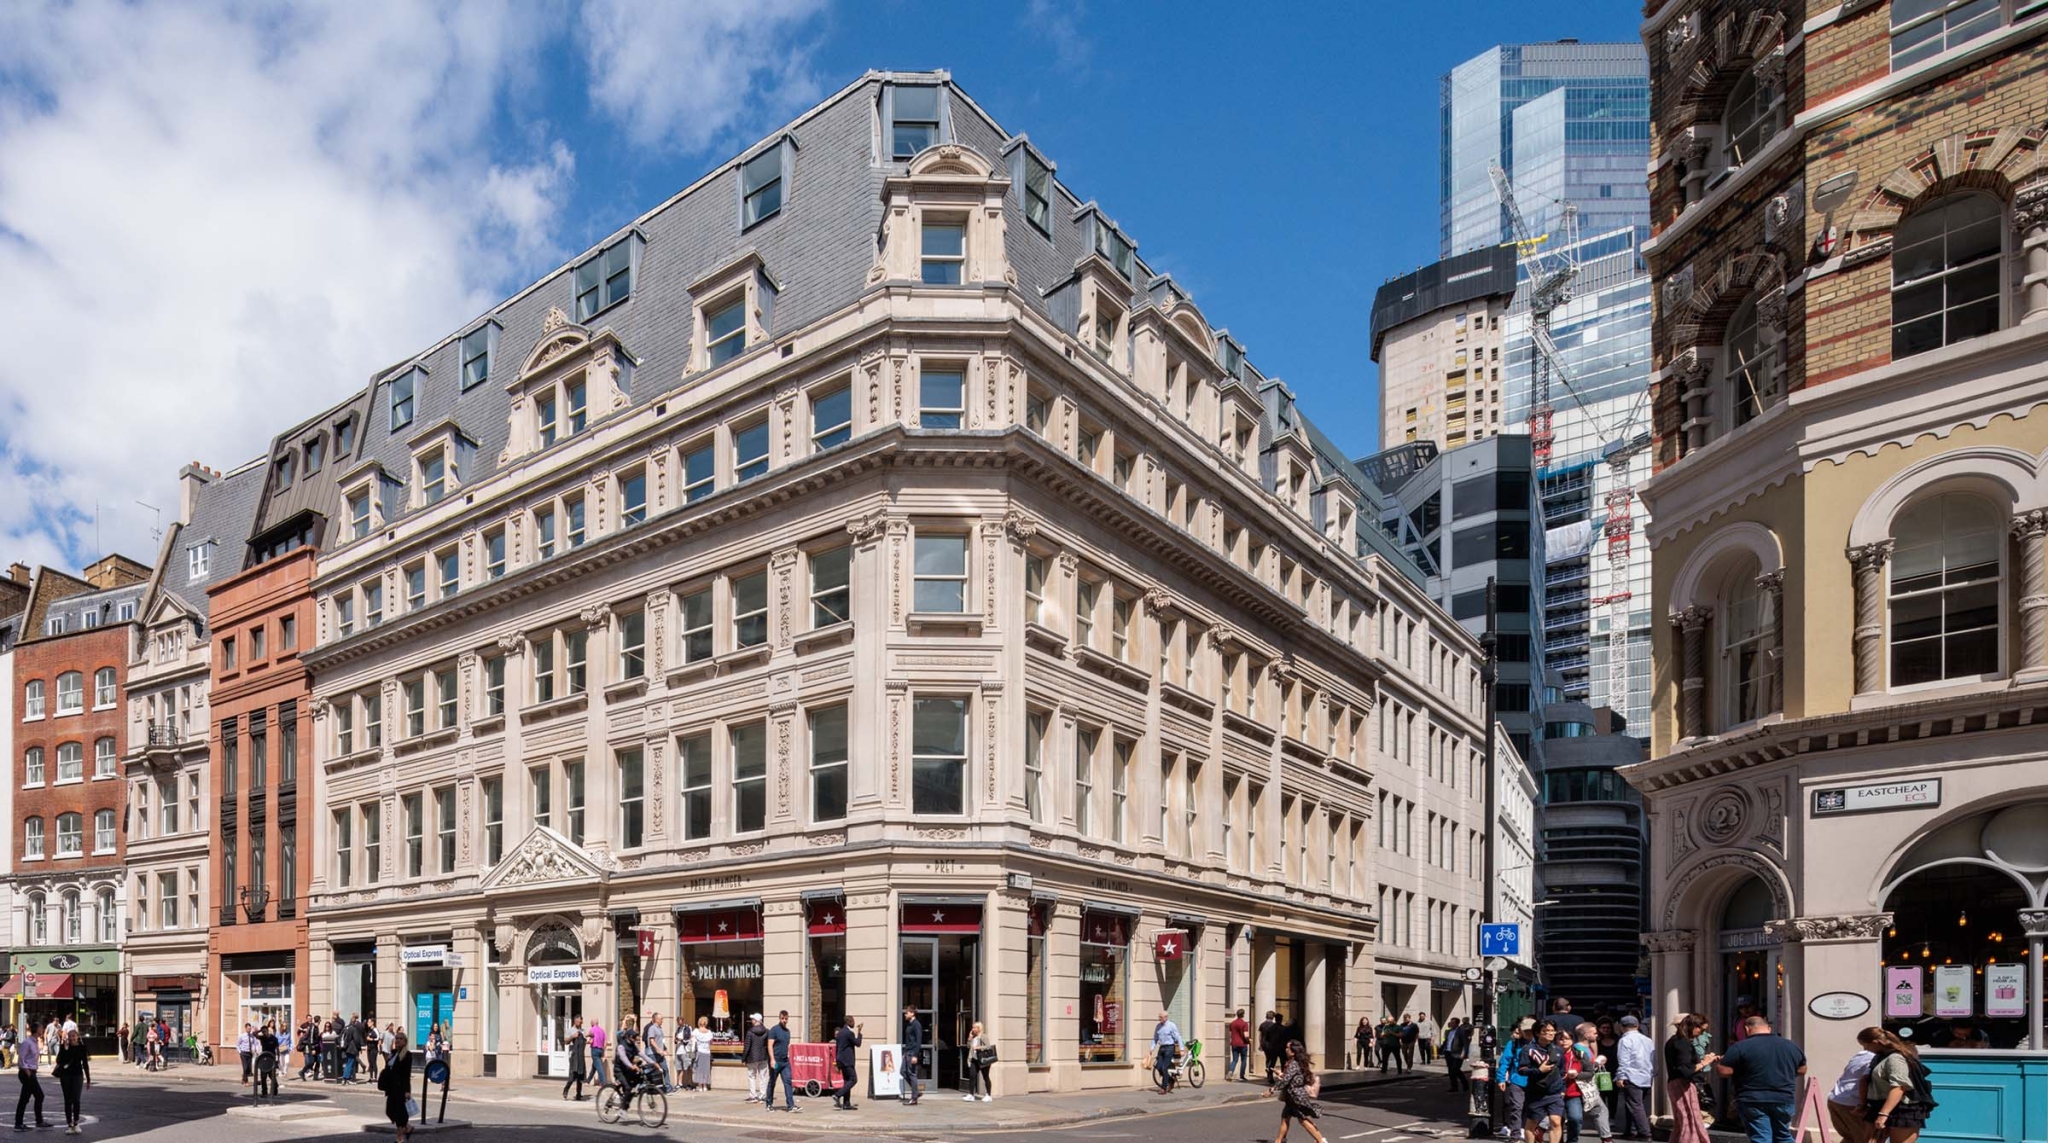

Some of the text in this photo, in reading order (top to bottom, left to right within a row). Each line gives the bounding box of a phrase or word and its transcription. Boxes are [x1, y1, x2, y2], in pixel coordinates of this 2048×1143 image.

[1858, 784, 1928, 798] EASTCHEAP
[1905, 793, 1928, 802] EC3
[1714, 805, 1740, 829] 23
[935, 859, 955, 874] PRET
[690, 878, 706, 892] PRET
[714, 874, 742, 890] MANGER
[1728, 933, 1745, 948] JOE
[1754, 931, 1772, 945] THE
[404, 949, 443, 960] Optical Express
[530, 969, 579, 980] Optical Express
[699, 963, 762, 980] PRET A MANGER
